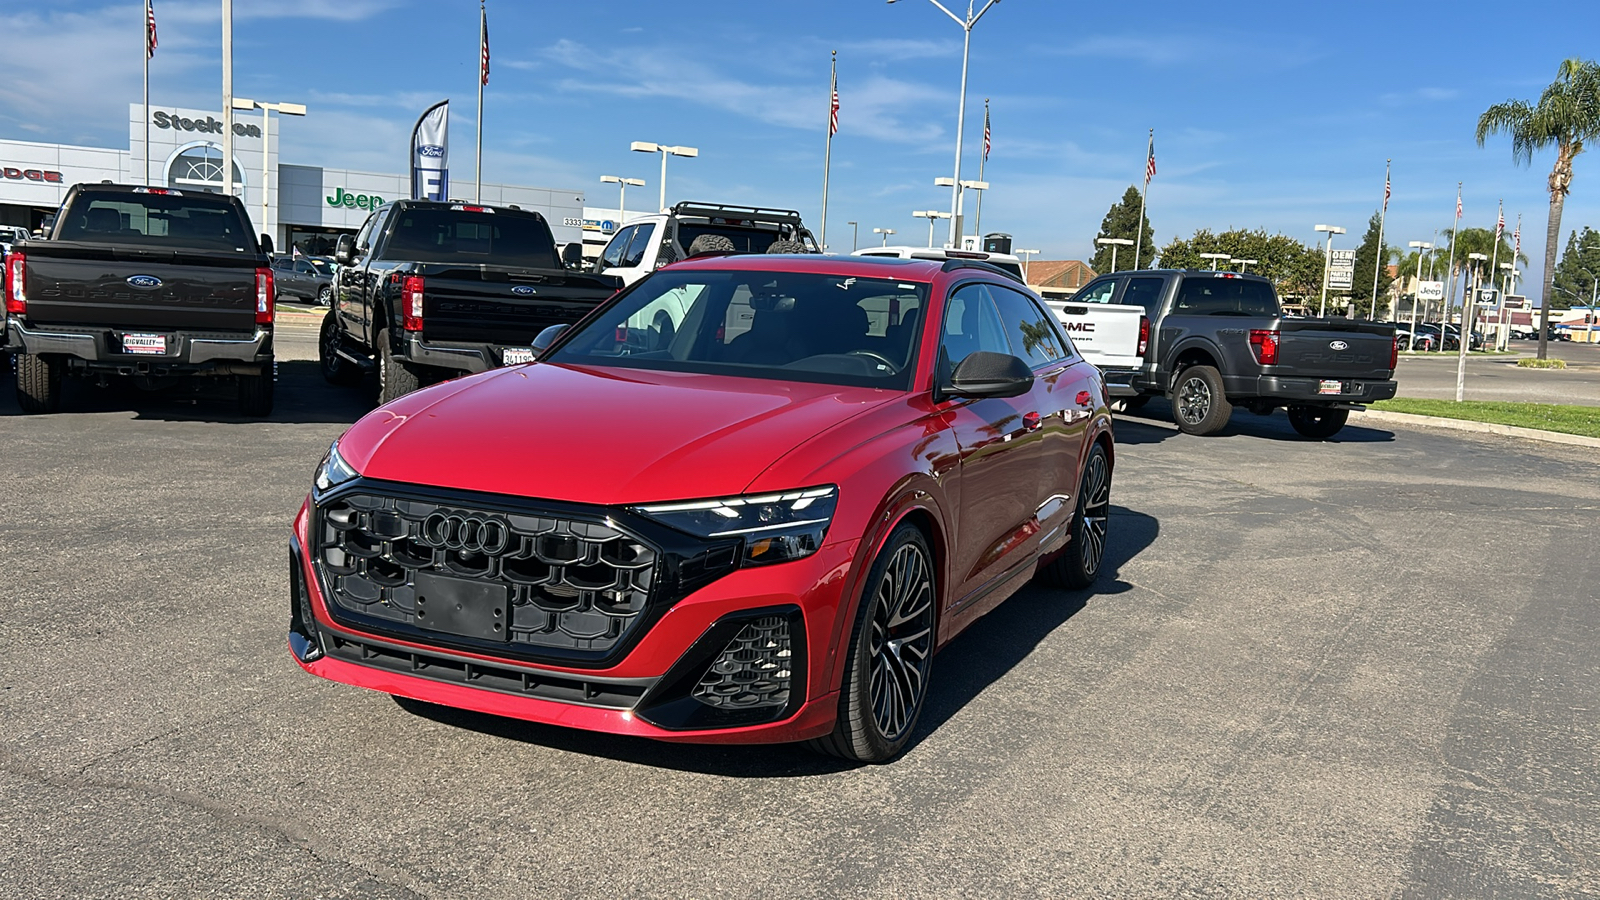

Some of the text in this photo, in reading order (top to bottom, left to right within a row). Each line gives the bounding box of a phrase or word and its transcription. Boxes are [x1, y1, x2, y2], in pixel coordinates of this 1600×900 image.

[153, 111, 261, 138] Stockon
[421, 146, 443, 157] Ford
[0, 167, 63, 183] DGE
[326, 187, 384, 212] Jeep
[564, 218, 582, 227] 3333
[1332, 251, 1353, 260] OEM
[1420, 286, 1441, 296] Jeep
[1060, 322, 1095, 332] GMC
[1330, 341, 1347, 350] Ford
